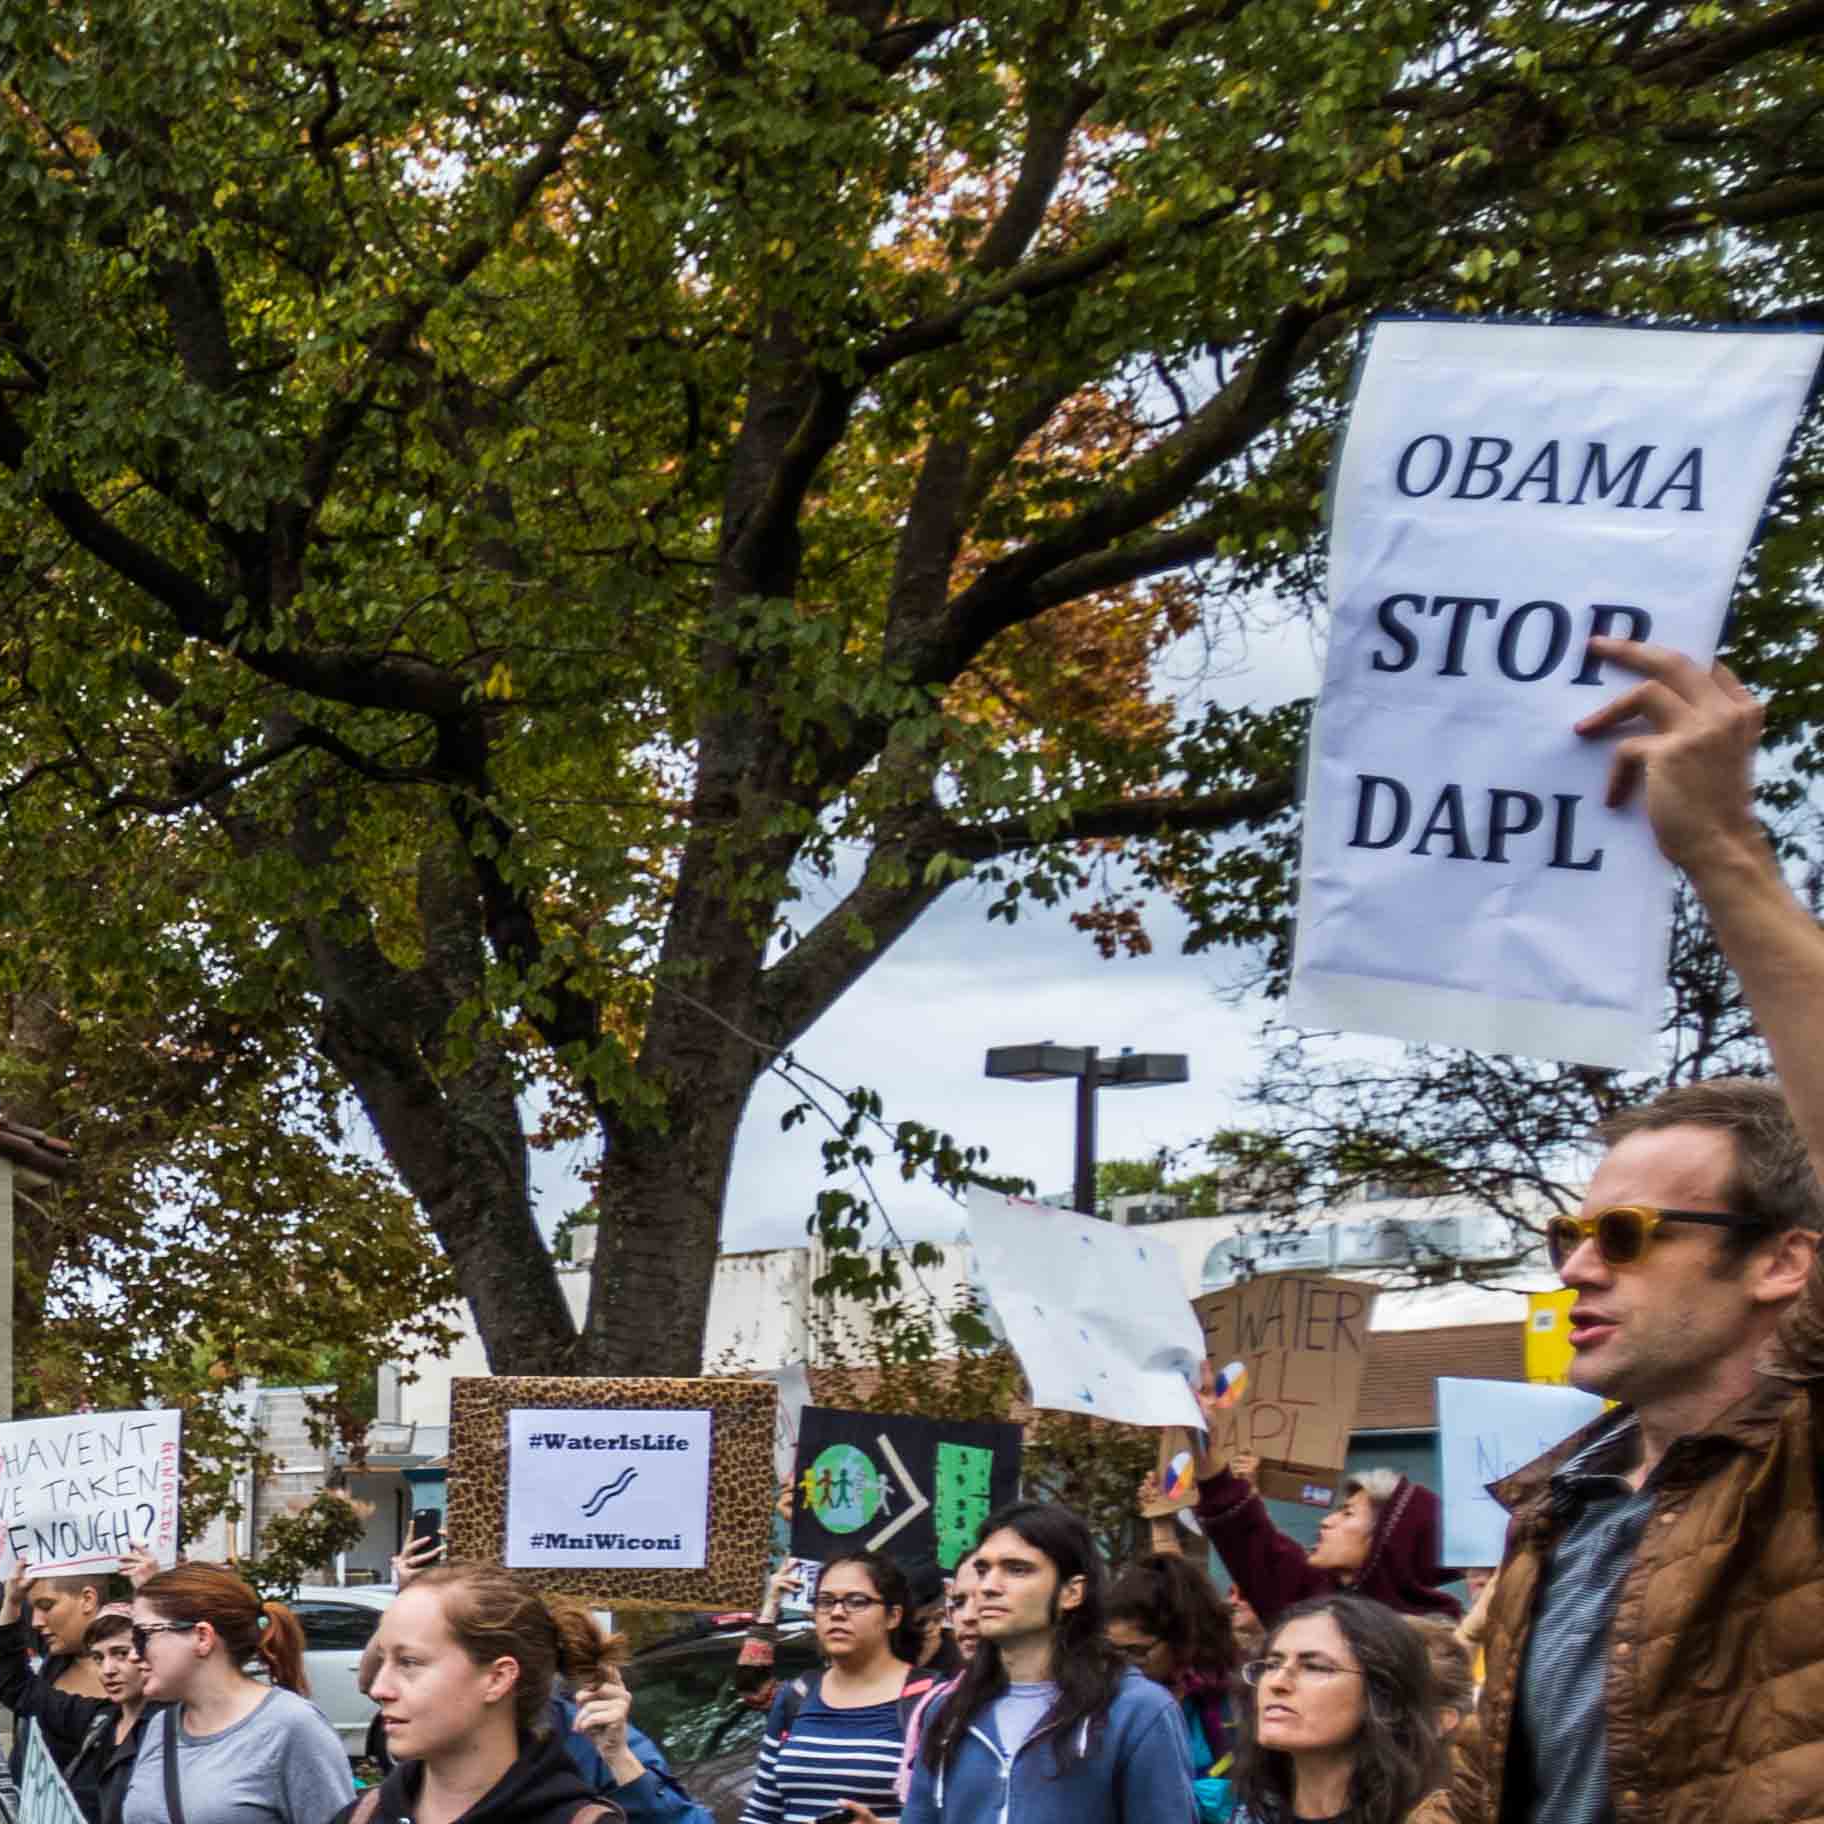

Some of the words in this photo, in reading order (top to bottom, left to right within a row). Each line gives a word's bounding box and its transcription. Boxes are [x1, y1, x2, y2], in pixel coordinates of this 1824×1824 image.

[1395, 434, 1705, 513] OBAMA
[1372, 593, 1652, 686] STOP
[1347, 774, 1605, 872] DAPL
[1235, 1279, 1360, 1353] WATER
[528, 1433, 690, 1453] #WaterIsLife
[41, 1461, 160, 1512] TAKEN
[8, 1504, 156, 1564] ENOUGH?
[529, 1533, 682, 1553] #MniWiconi
